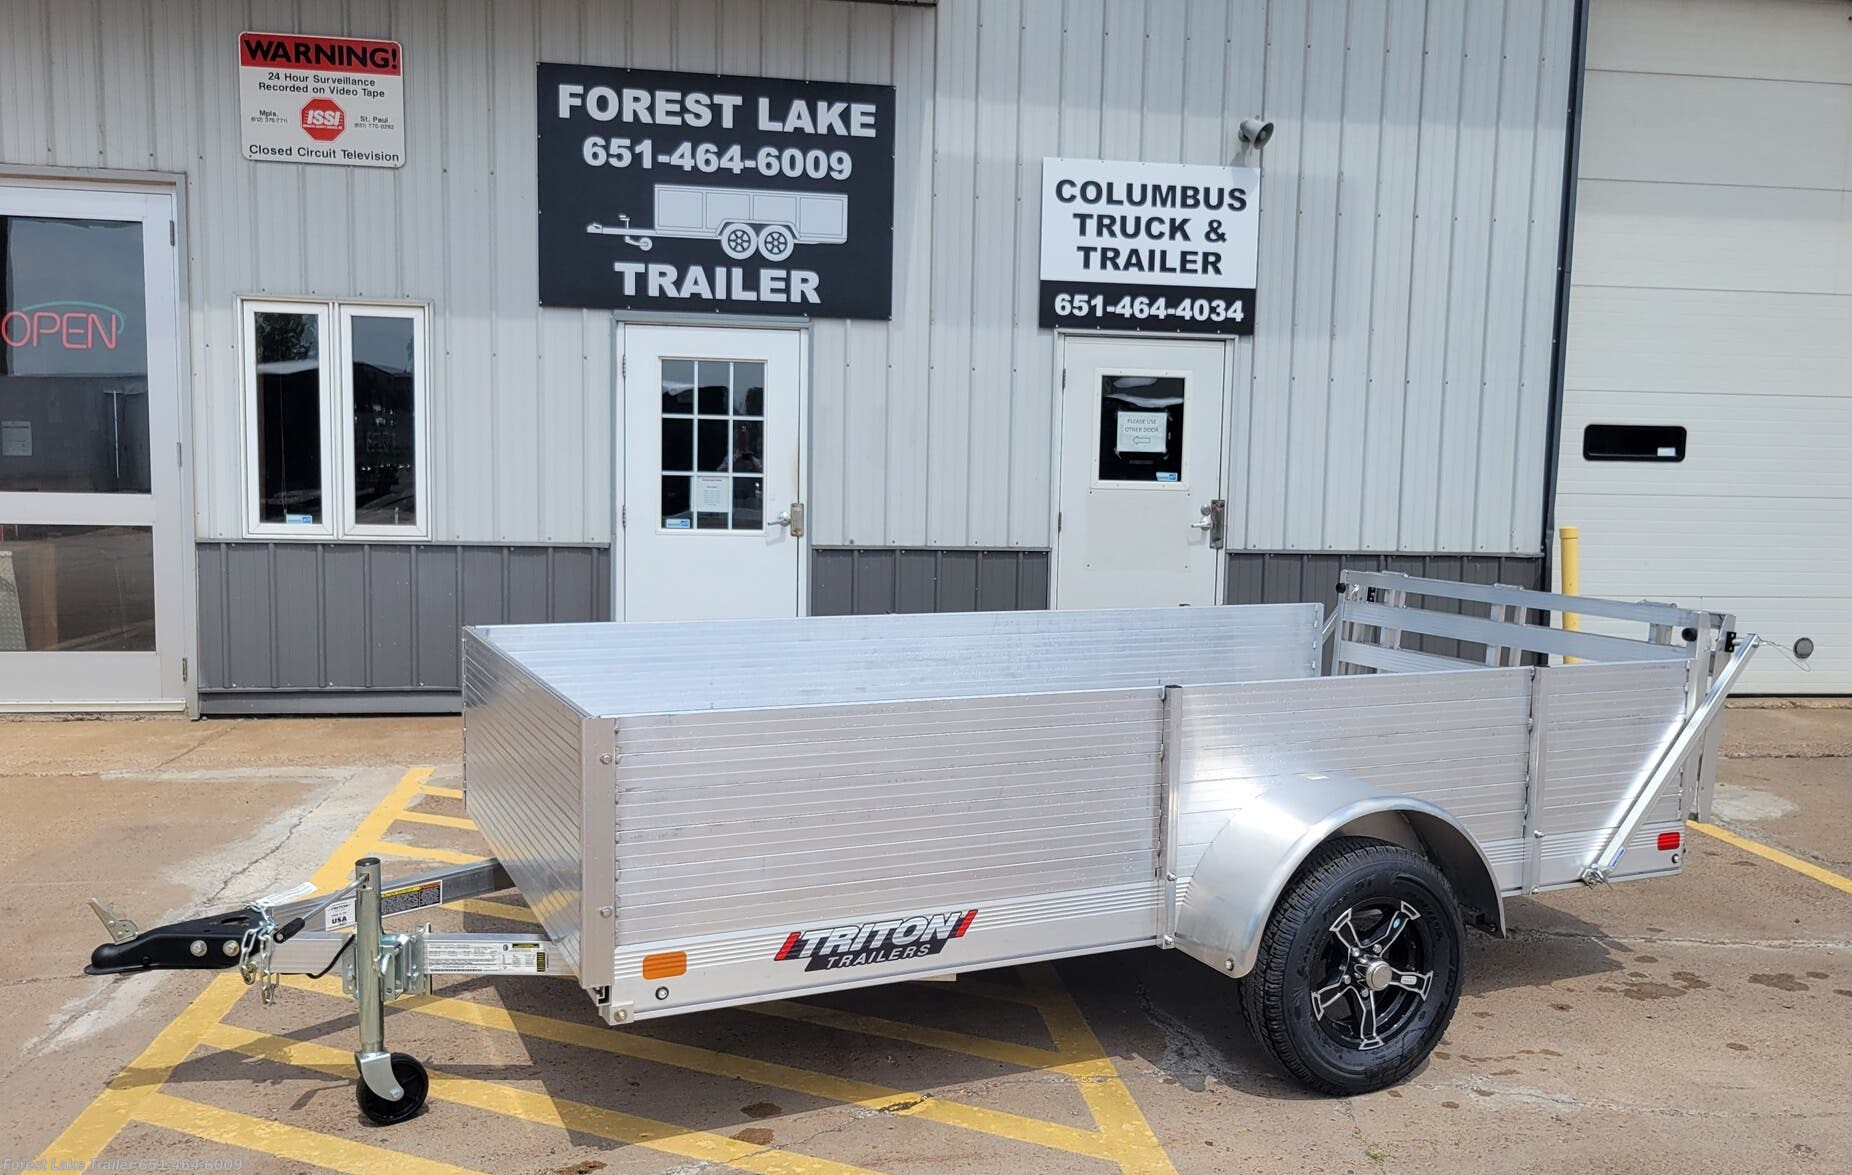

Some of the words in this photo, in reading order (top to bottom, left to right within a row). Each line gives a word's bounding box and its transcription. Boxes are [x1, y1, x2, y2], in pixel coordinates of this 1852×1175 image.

[244, 39, 398, 69] WARNING!
[258, 82, 308, 93] Recorded
[329, 86, 358, 96] Video
[362, 88, 385, 99] Tape
[268, 72, 281, 81] 24
[285, 73, 309, 83] Hour
[313, 75, 376, 87] Surveillance
[306, 110, 341, 126] ISSI
[558, 84, 743, 129] FOREST
[758, 97, 877, 138] LAKE
[249, 144, 293, 156] Closed
[297, 147, 336, 158] Circuit
[341, 149, 399, 162] Television
[583, 136, 853, 181] 651-464-6009
[1055, 179, 1247, 212] COLUMBUS
[1073, 213, 1192, 242] TRUCK
[1204, 219, 1227, 243] &
[1077, 246, 1223, 275] TRAILER
[614, 261, 821, 304] TRAILER
[1054, 293, 1244, 322] 651-464-4034
[1, 311, 117, 349] OPEN
[331, 916, 347, 924] USA
[800, 911, 962, 958] TRITON
[827, 943, 931, 969] TRAILERS
